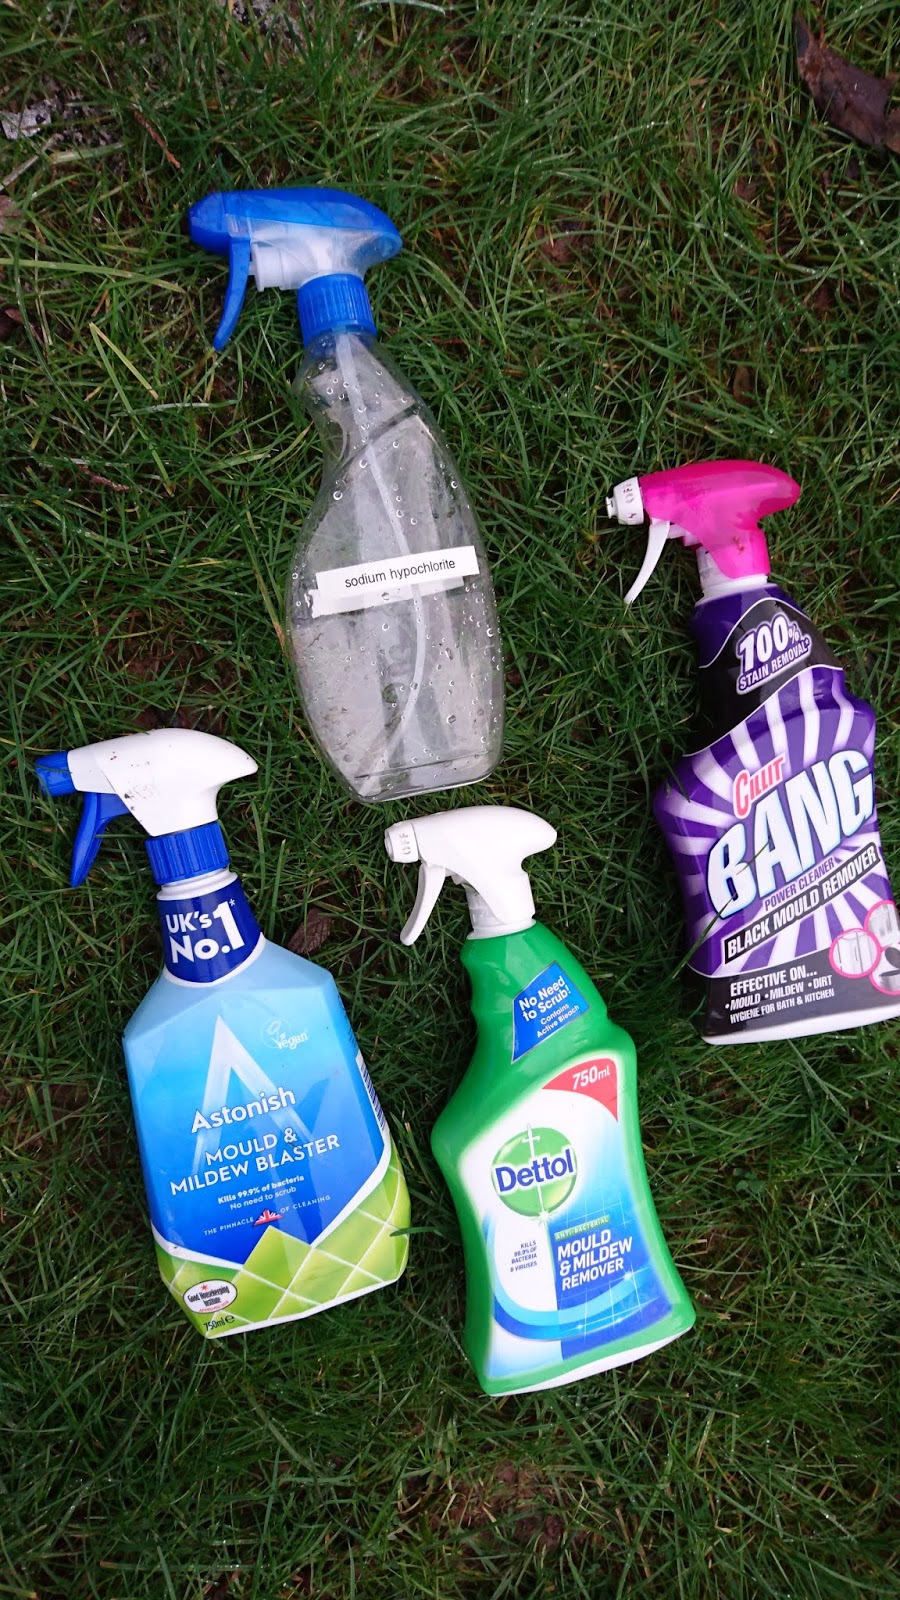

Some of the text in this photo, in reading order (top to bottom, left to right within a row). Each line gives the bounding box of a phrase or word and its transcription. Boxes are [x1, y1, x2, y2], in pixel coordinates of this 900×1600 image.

[345, 559, 456, 588] sodium hypochlorite
[739, 615, 799, 673] 100%
[739, 664, 770, 689] STAIN
[707, 750, 873, 919] BANG
[765, 857, 835, 911] POWER CLEANER
[727, 848, 877, 959] BLACK MOULD REMOVER
[166, 911, 212, 933] UK's
[518, 975, 566, 1012] No Need
[730, 970, 787, 997] EFFECTIVE
[522, 985, 571, 1022] to Scrub!
[540, 1004, 569, 1025] Contains
[730, 988, 835, 1024] HYGIENE FOR BATH & KITCHEN
[536, 1005, 580, 1038] Active Bleach
[271, 1032, 308, 1050] Vegan
[572, 1065, 610, 1090] 750ml
[191, 1087, 296, 1134] Astonish
[205, 1127, 298, 1165] MOULD &
[170, 1134, 340, 1196] MILDEW BLASTER
[495, 1149, 574, 1192] Dettol
[217, 1175, 305, 1204] Kills 99.9% of bacteria
[230, 1186, 297, 1210] No need to scrub
[203, 1227, 217, 1236] THE
[220, 1216, 254, 1231] PINNACLE
[293, 1194, 331, 1210] CLEANING
[511, 1253, 537, 1264] BACTERIA
[520, 1240, 536, 1249] KILLS
[557, 1229, 611, 1261] MOULD
[559, 1236, 633, 1277] & MILDEW
[515, 1260, 538, 1271] VIRUSES
[562, 1257, 624, 1291] REMOVER
[204, 1318, 225, 1331] 750ml
